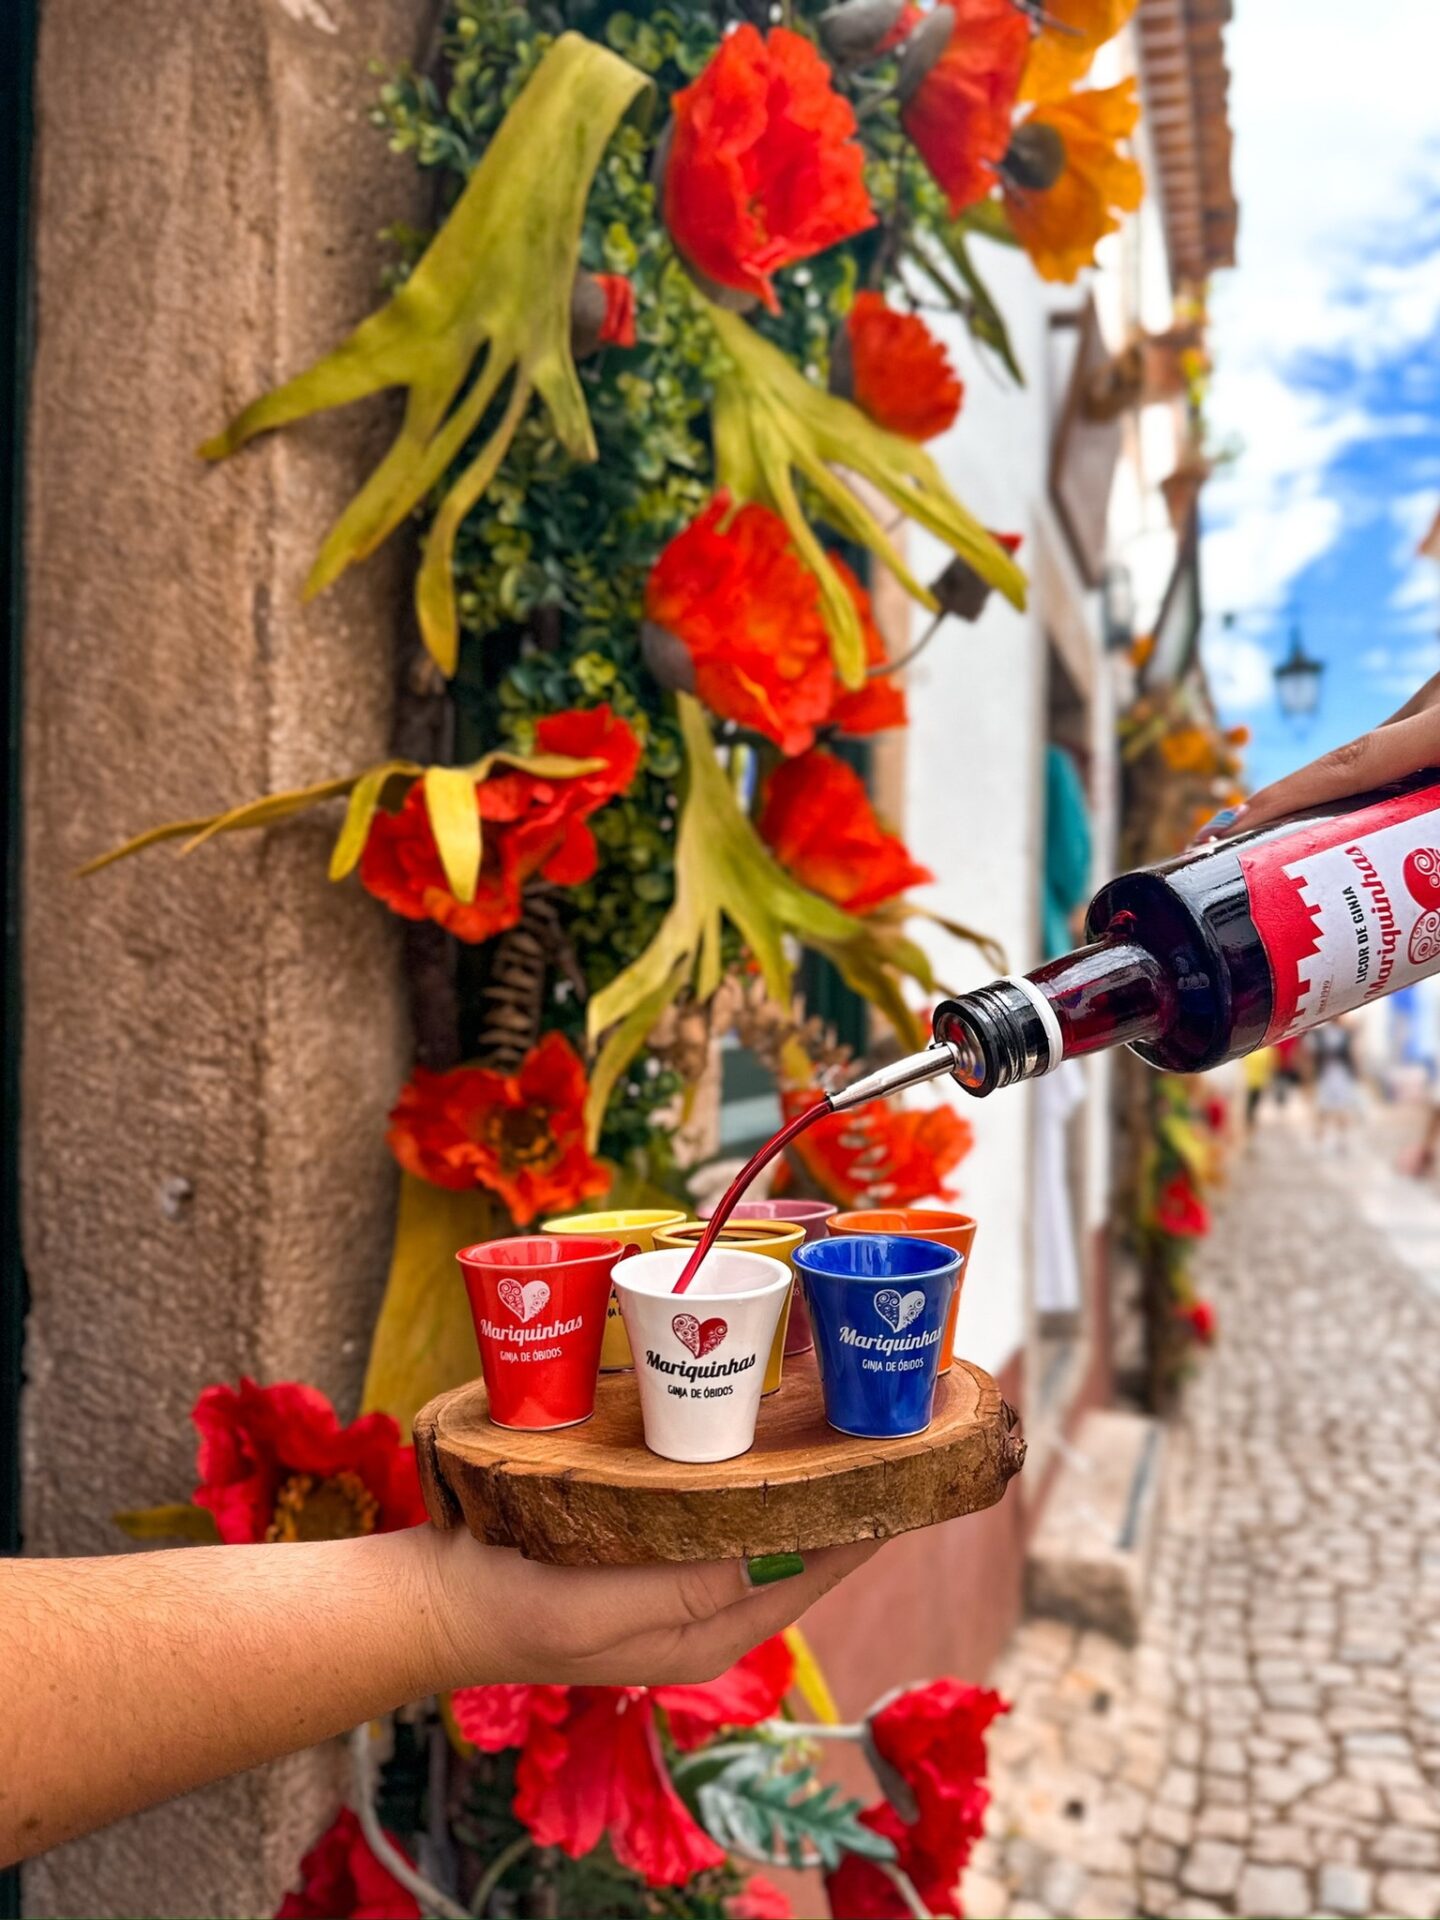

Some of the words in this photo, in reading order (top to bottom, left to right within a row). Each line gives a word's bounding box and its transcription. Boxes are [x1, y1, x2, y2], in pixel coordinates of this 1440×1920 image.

[1342, 886, 1365, 924] GINJA
[1344, 846, 1403, 999] Mariquinhas
[1355, 925, 1369, 945] DE
[1355, 946, 1370, 984] LICOR
[480, 1315, 583, 1347] Mariquinhas
[839, 1326, 942, 1356] Mariquinhas
[500, 1350, 519, 1364] GINJA
[520, 1351, 531, 1362] DE
[532, 1346, 562, 1361] ÓBIDOS
[646, 1350, 756, 1383] Mariquinhas
[862, 1359, 883, 1373] GINJA
[885, 1361, 896, 1371] DE
[897, 1357, 924, 1371] ÓBIDOS
[667, 1384, 688, 1399] GINJA
[690, 1387, 701, 1398] DE
[703, 1384, 734, 1398] ÓBIDOS
